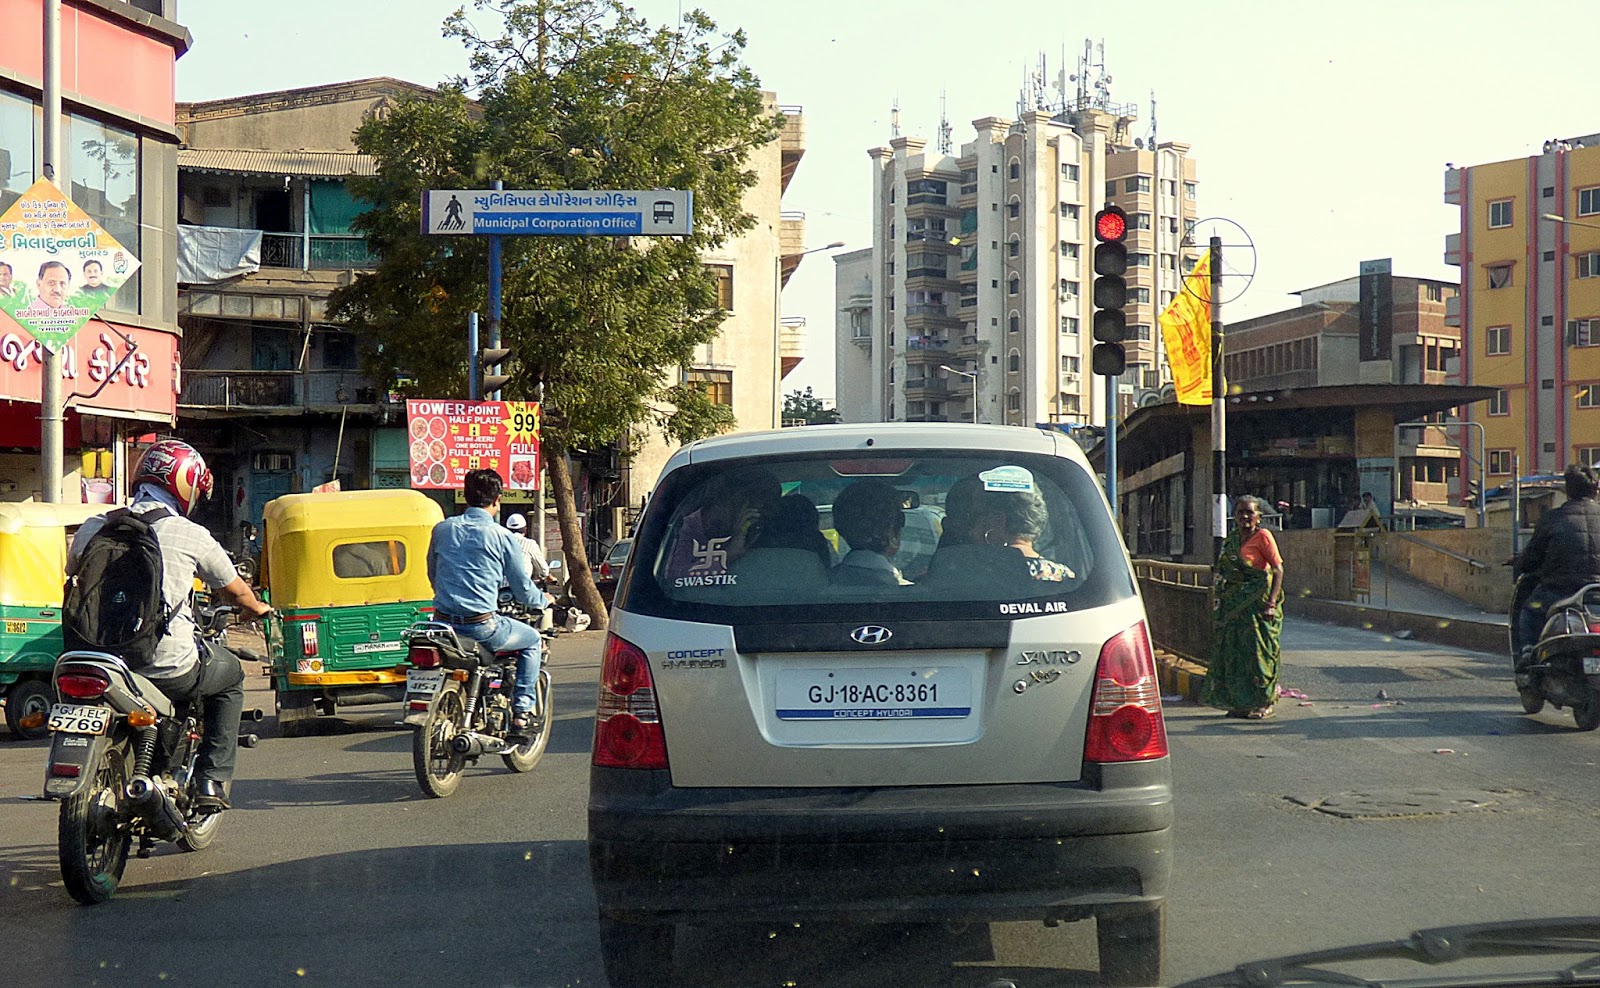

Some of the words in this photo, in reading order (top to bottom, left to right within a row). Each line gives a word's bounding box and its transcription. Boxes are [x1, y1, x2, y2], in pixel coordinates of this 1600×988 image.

[474, 193, 536, 210] મ્યુનિસિપલ
[539, 193, 592, 206] કોર્પોરેશન
[595, 193, 637, 207] ઓફિસ
[474, 217, 528, 229] Municipal
[532, 217, 599, 229] Corporation
[602, 217, 637, 228] Office
[12, 232, 96, 254] મિલાદુન્નબી
[410, 402, 465, 415] TOWER
[468, 406, 500, 415] POINT
[474, 416, 502, 424] PLATE
[514, 413, 535, 432] 99
[449, 448, 471, 456] FULL
[473, 449, 501, 457] PLATE
[510, 443, 537, 454] FULL
[674, 574, 738, 588] SWASTIK
[1000, 602, 1043, 614] DEVAL
[1045, 601, 1068, 612] AIR
[667, 649, 724, 659] CONCEPT
[1017, 650, 1082, 665] SANTRO
[662, 659, 727, 669] HYUNDAI
[834, 710, 874, 718] CONCEPT
[876, 709, 913, 717] HYUNDAI
[49, 716, 103, 732] 5769
